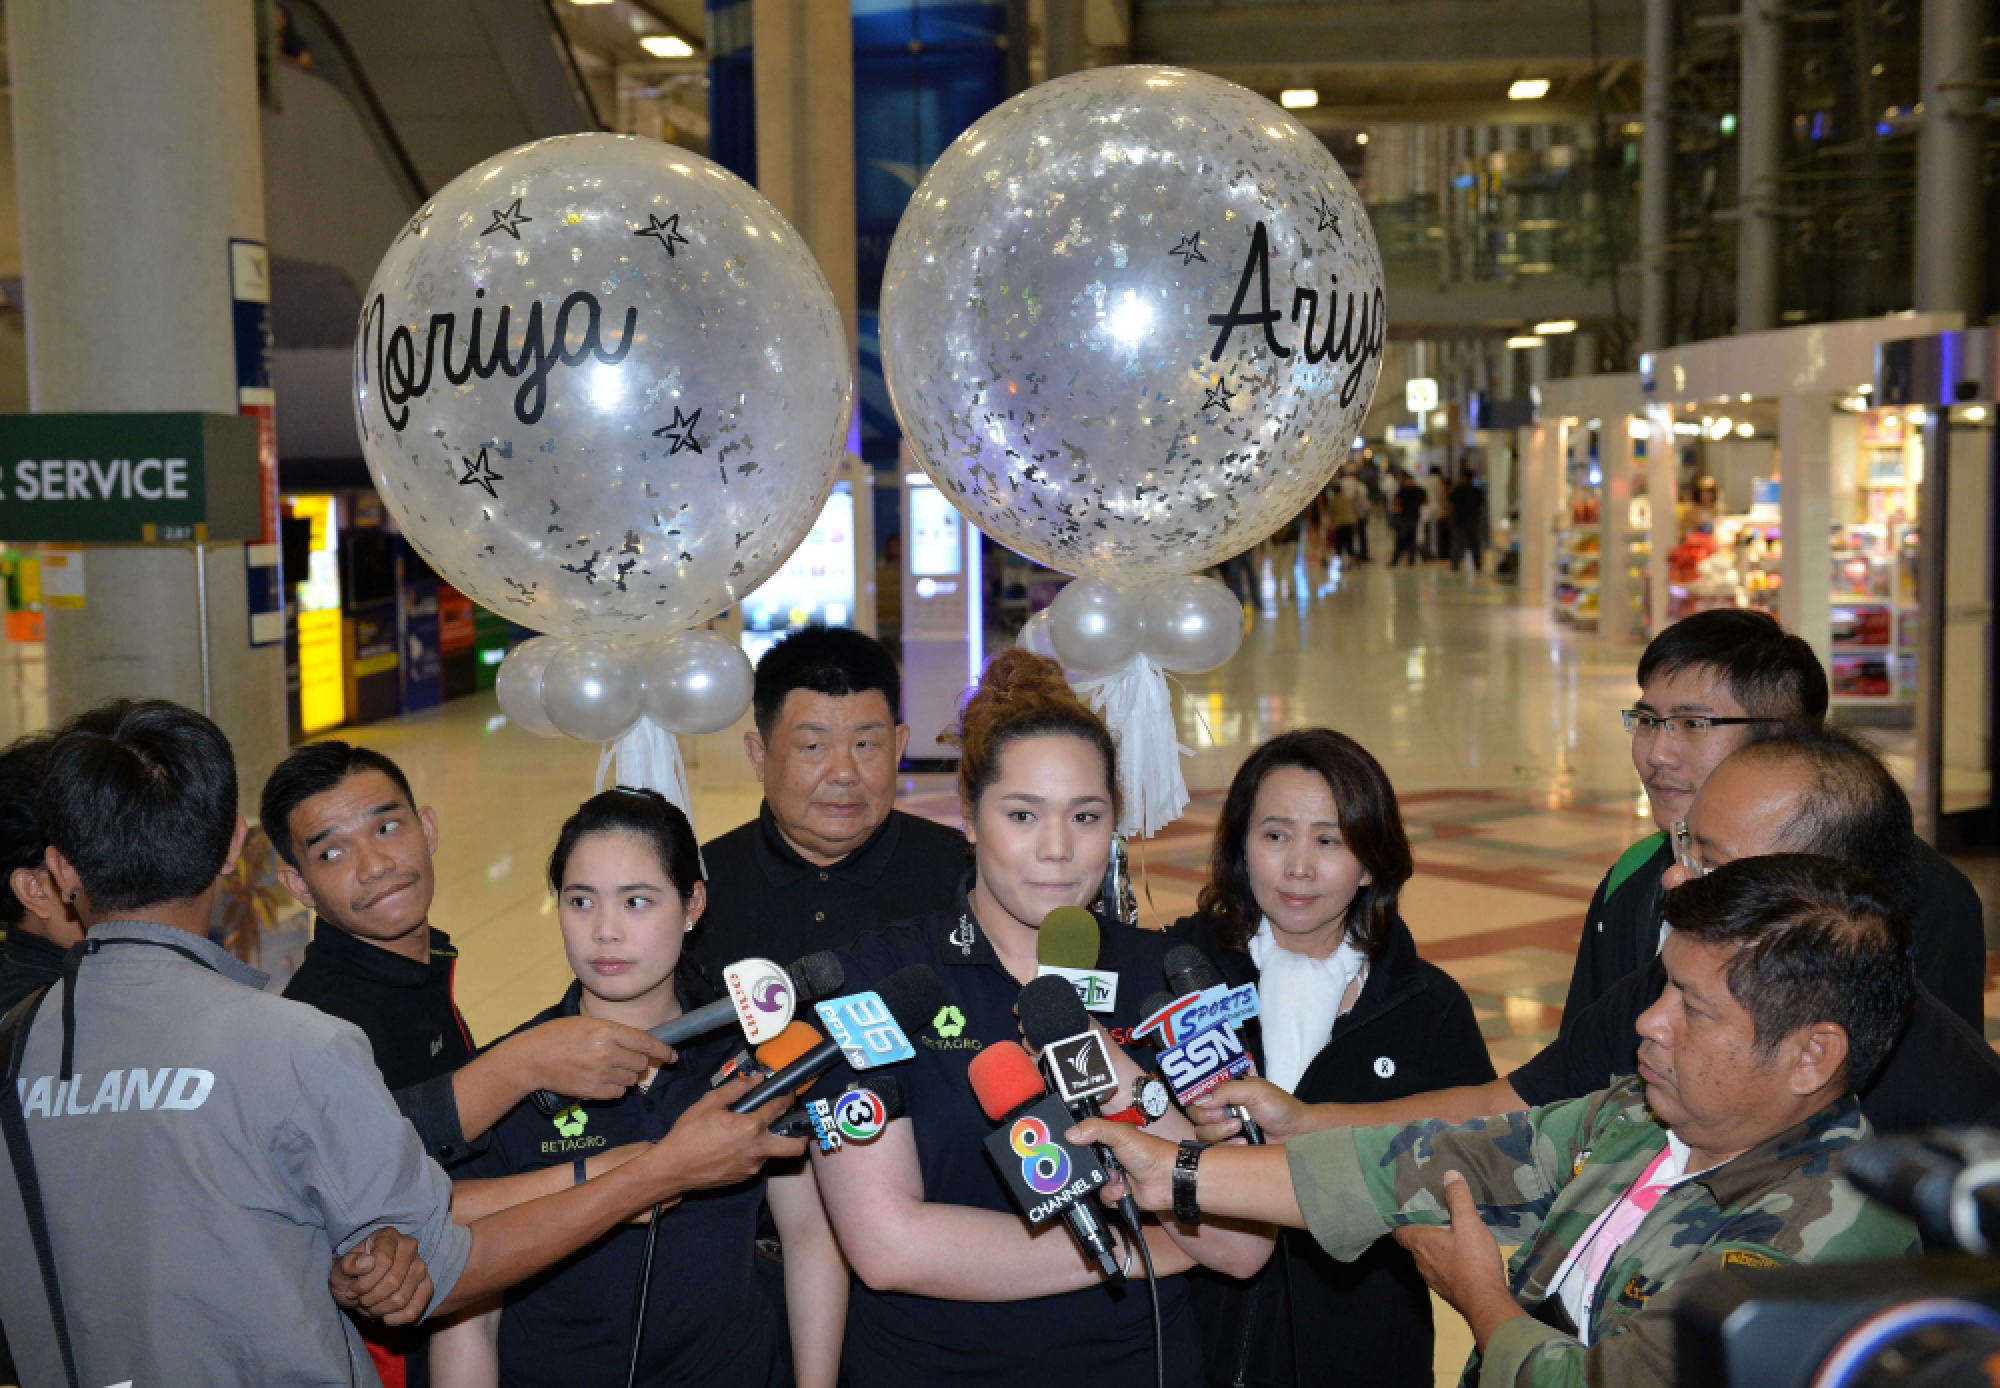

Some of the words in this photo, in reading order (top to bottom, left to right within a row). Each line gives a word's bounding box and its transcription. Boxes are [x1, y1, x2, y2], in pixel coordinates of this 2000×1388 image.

[15, 458, 189, 501] SERVICE
[843, 1000, 909, 1053] 36
[1162, 1021, 1242, 1088] SSN
[815, 1098, 842, 1148] BEC
[846, 1101, 873, 1126] 3
[541, 1136, 607, 1153] BETAGRO
[1029, 1178, 1092, 1222] CHANNEL
[1091, 1169, 1103, 1183] 8
